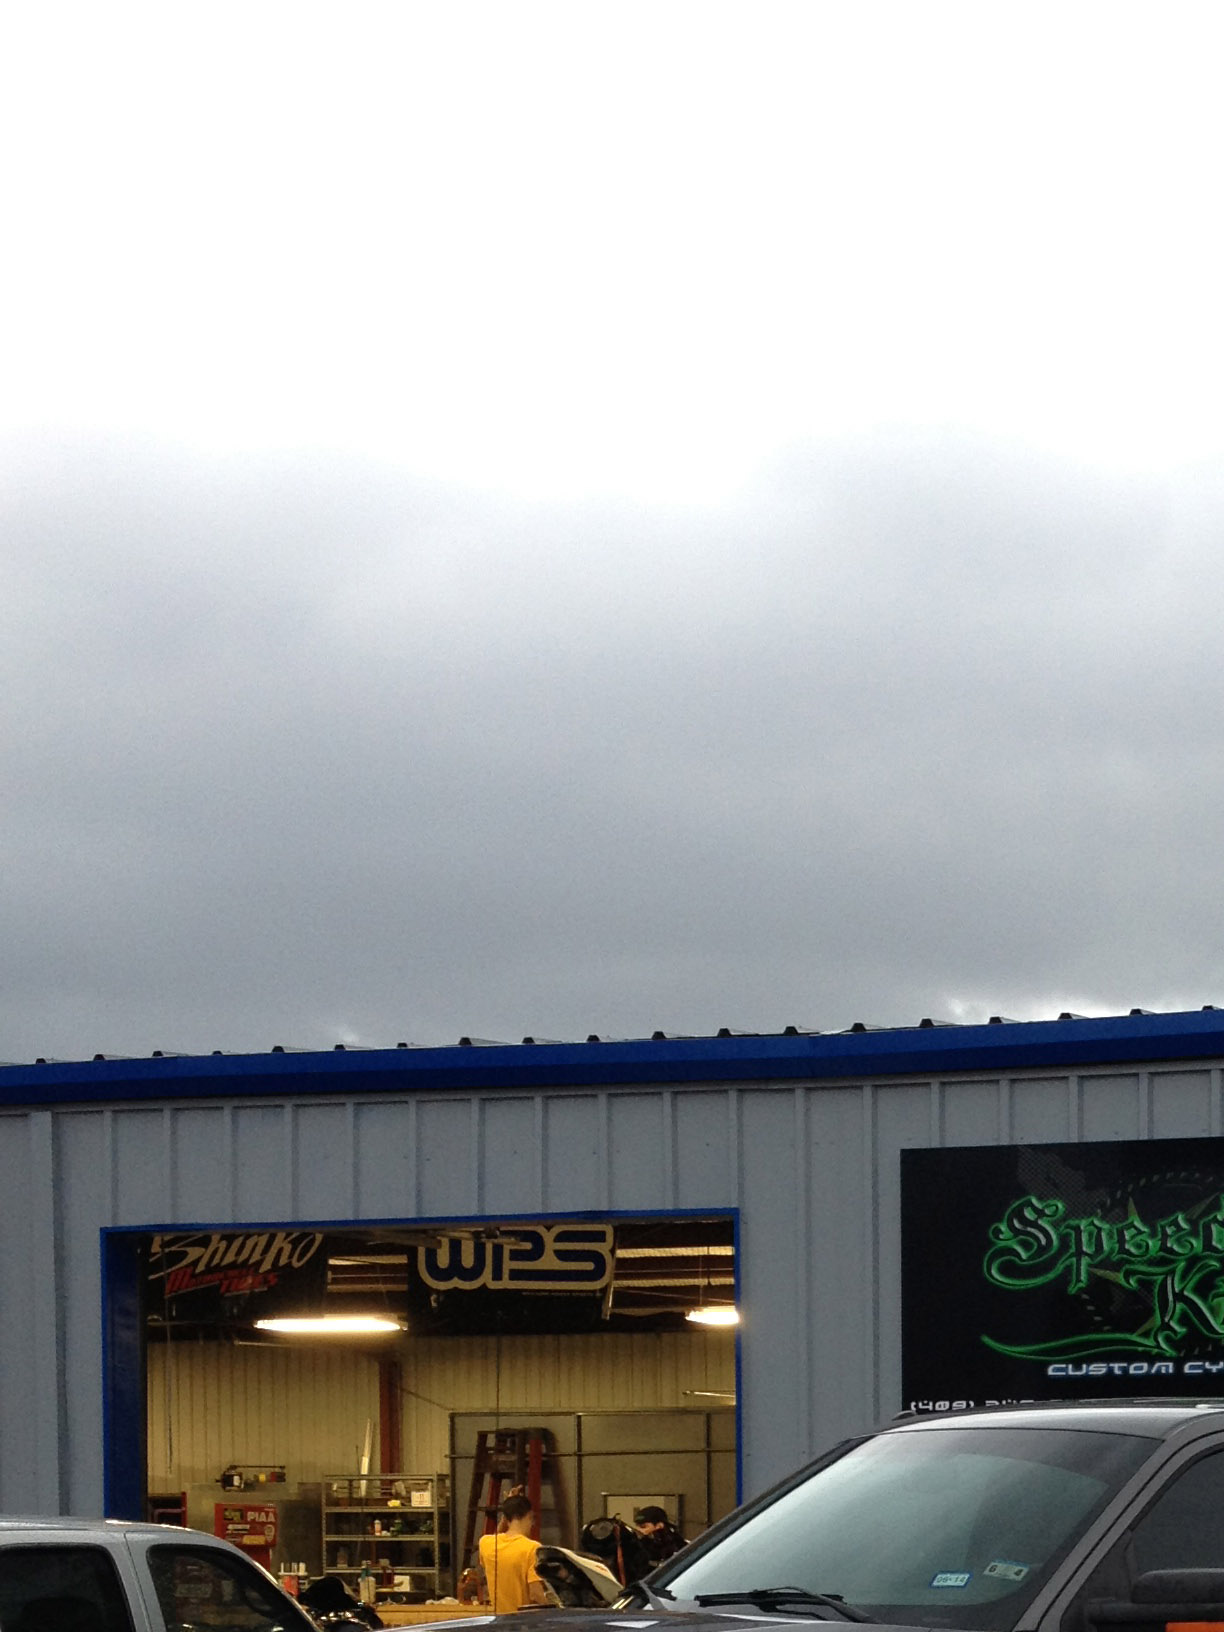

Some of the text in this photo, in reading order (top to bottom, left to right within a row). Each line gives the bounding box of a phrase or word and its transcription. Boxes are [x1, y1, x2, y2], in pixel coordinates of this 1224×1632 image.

[418, 1225, 614, 1290] WPS
[1047, 1361, 1174, 1376] CUSTOM
[247, 1511, 276, 1522] PIAA
